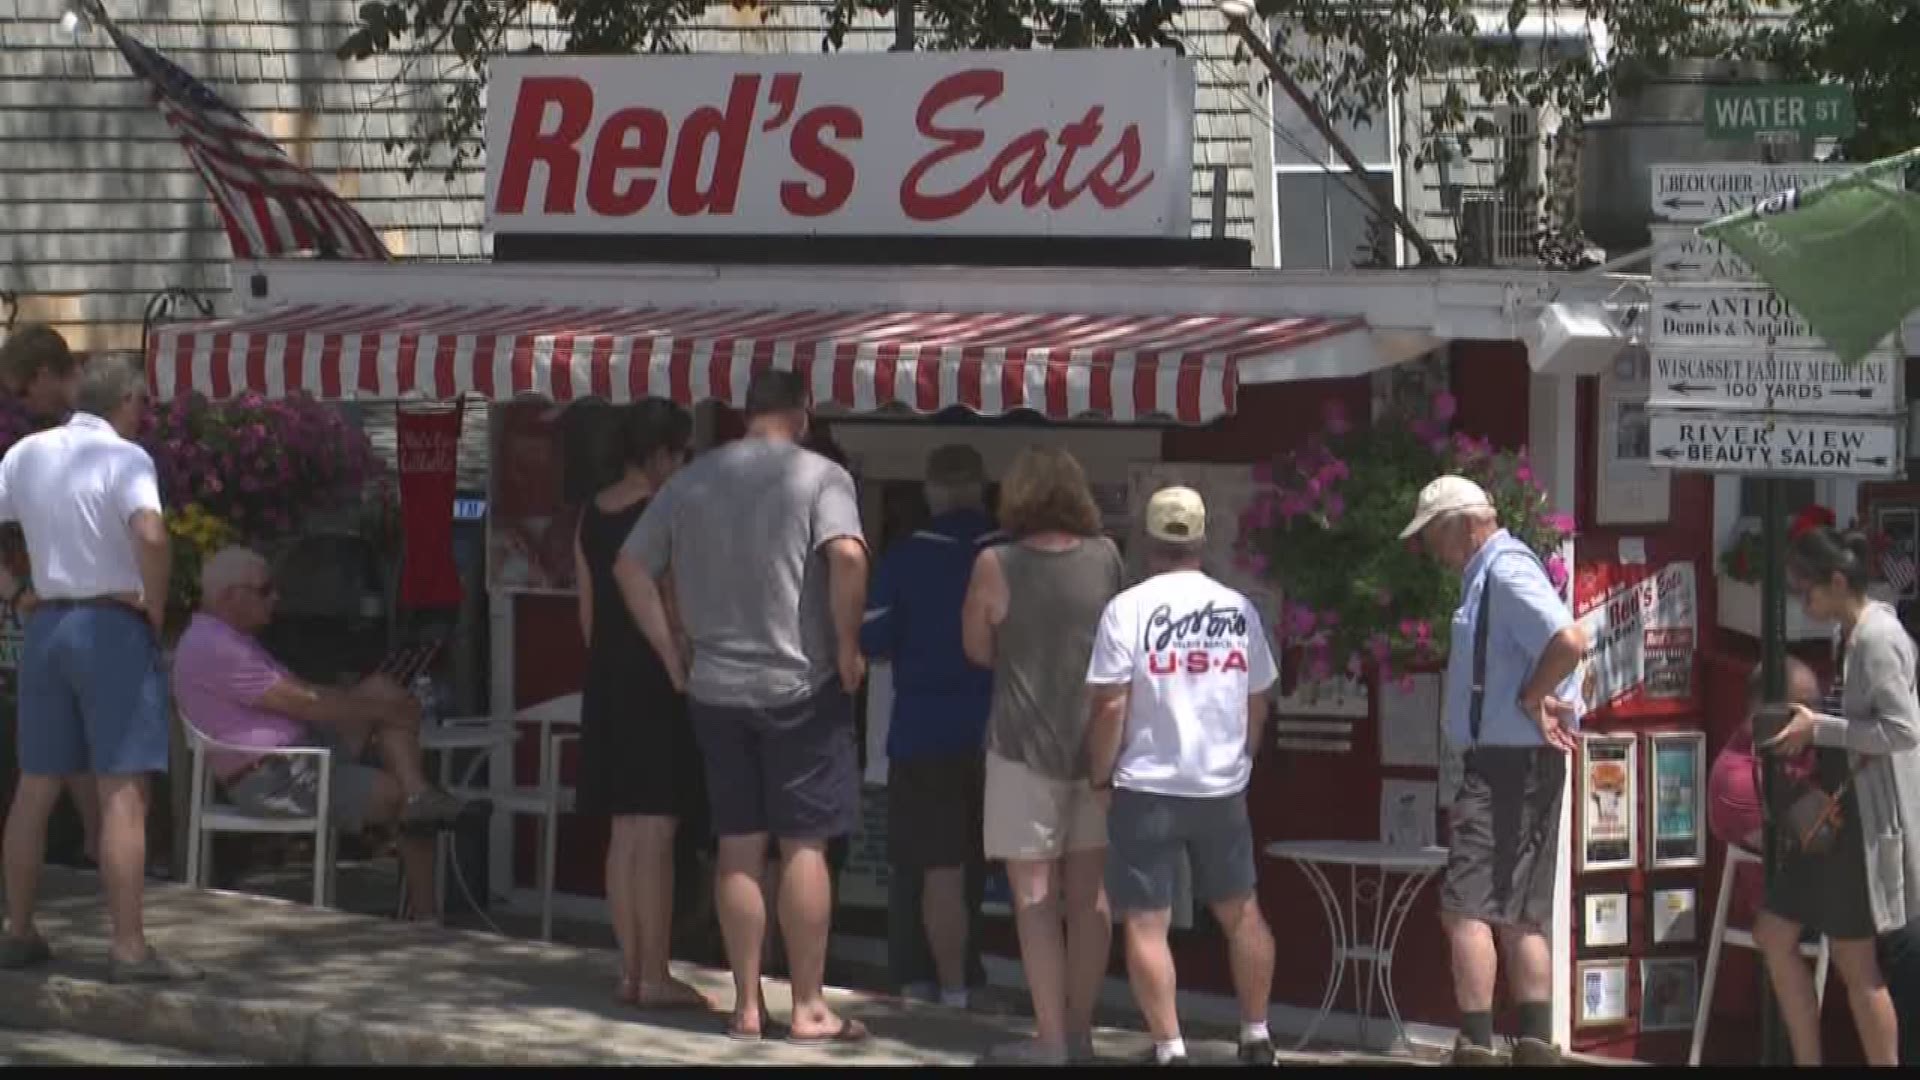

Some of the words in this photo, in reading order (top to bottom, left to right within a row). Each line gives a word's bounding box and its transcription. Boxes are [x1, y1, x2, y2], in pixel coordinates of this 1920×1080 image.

[1715, 97, 1806, 129] WATER
[1815, 100, 1839, 121] ST
[495, 71, 864, 216] Red's
[898, 67, 1155, 222] Eats
[1663, 317, 1720, 337] Dennis
[1724, 320, 1737, 337] &
[1658, 358, 1741, 381] WISCASSET
[1746, 359, 1803, 382] FAMILY
[1807, 362, 1888, 385] MEDICINE
[1726, 383, 1758, 397] 100
[1766, 383, 1823, 398] YARDS
[1679, 424, 1769, 446] RIVER
[1786, 428, 1865, 449] VIEW
[1687, 444, 1772, 464] BEAUTY
[1780, 449, 1851, 468] SALON
